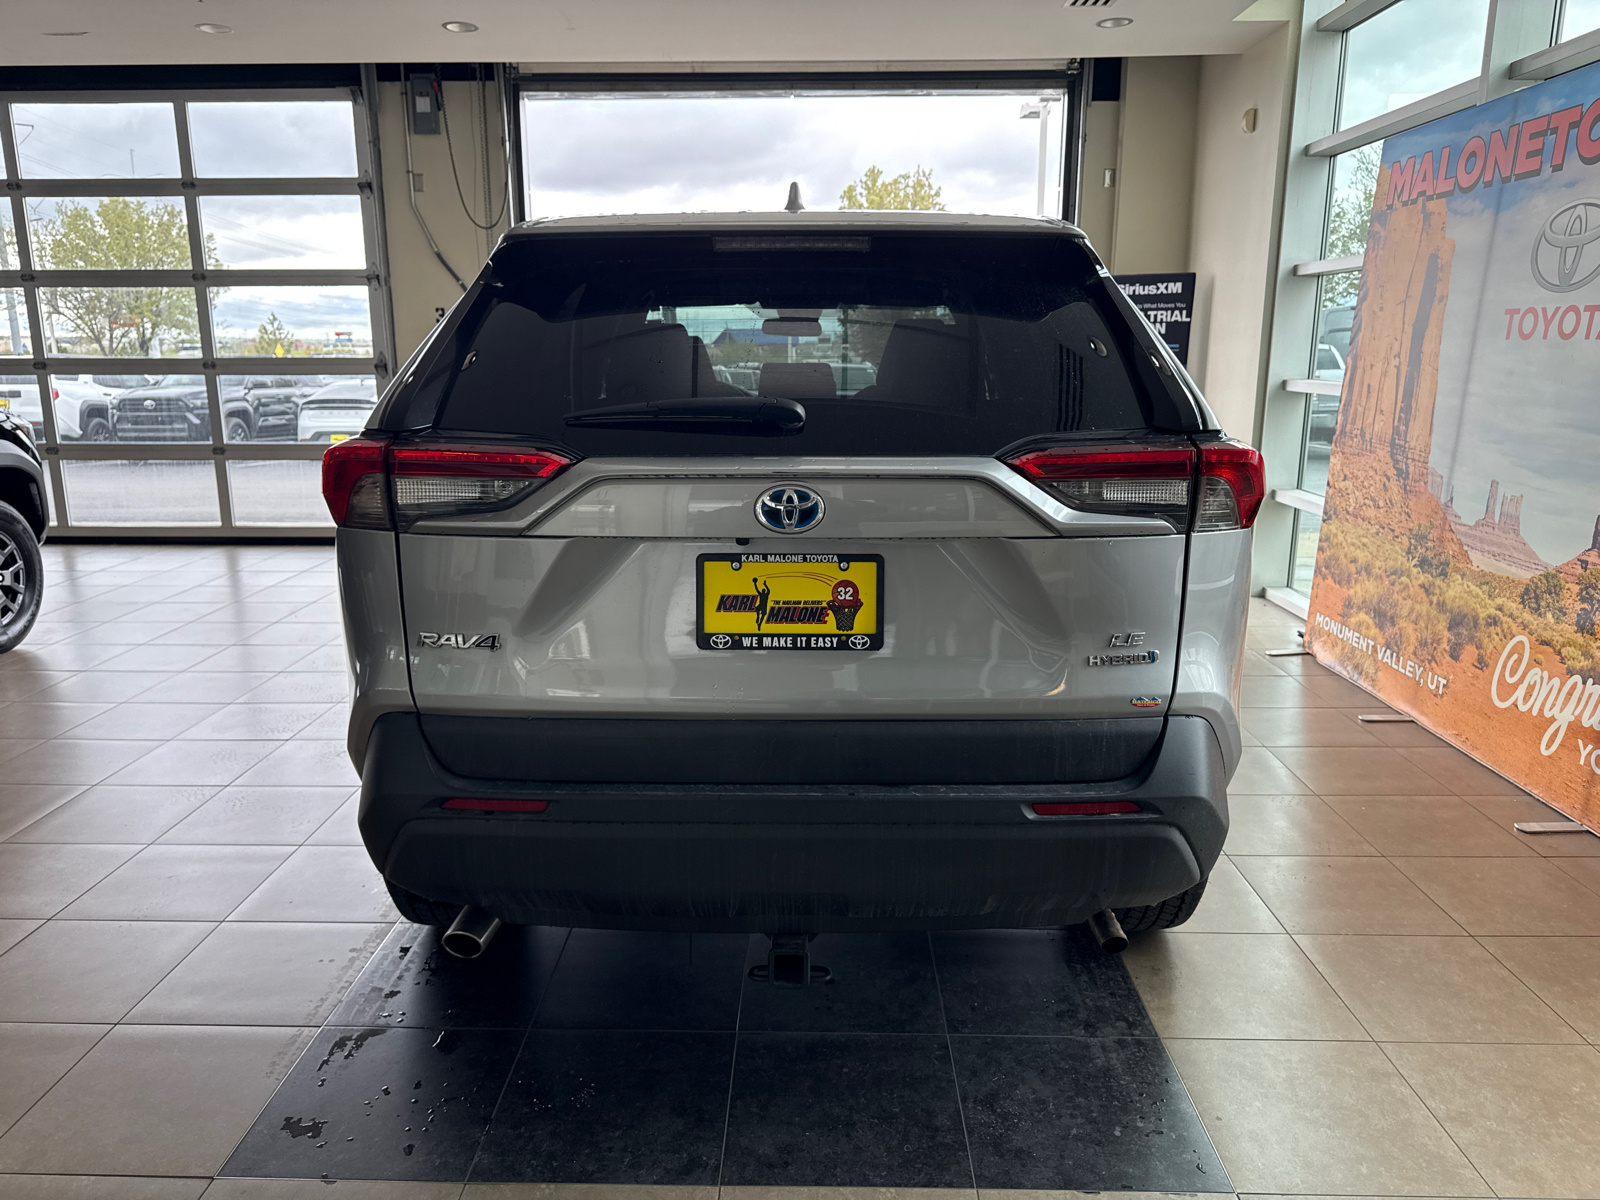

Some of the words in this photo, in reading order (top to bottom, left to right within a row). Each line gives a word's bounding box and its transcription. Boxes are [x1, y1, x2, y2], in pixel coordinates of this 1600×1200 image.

[1147, 310, 1191, 322] TRIAL
[1504, 303, 1600, 341] TOYOT
[741, 554, 765, 562] KARL
[767, 554, 803, 562] MALONE
[805, 554, 839, 562] TOYOTA
[837, 587, 853, 600] 32
[716, 594, 759, 612] KARL
[765, 606, 829, 624] MALONE
[416, 631, 501, 652] RAV4
[742, 637, 758, 647] WE
[763, 637, 795, 647] MAKE
[797, 637, 807, 647] IT
[811, 637, 838, 648] EASY
[1108, 631, 1146, 648] LE
[1087, 652, 1150, 667] HYBRID
[1315, 612, 1374, 655] MONUMENT
[1377, 644, 1423, 686] VALLEY,
[1427, 671, 1447, 695] UT
